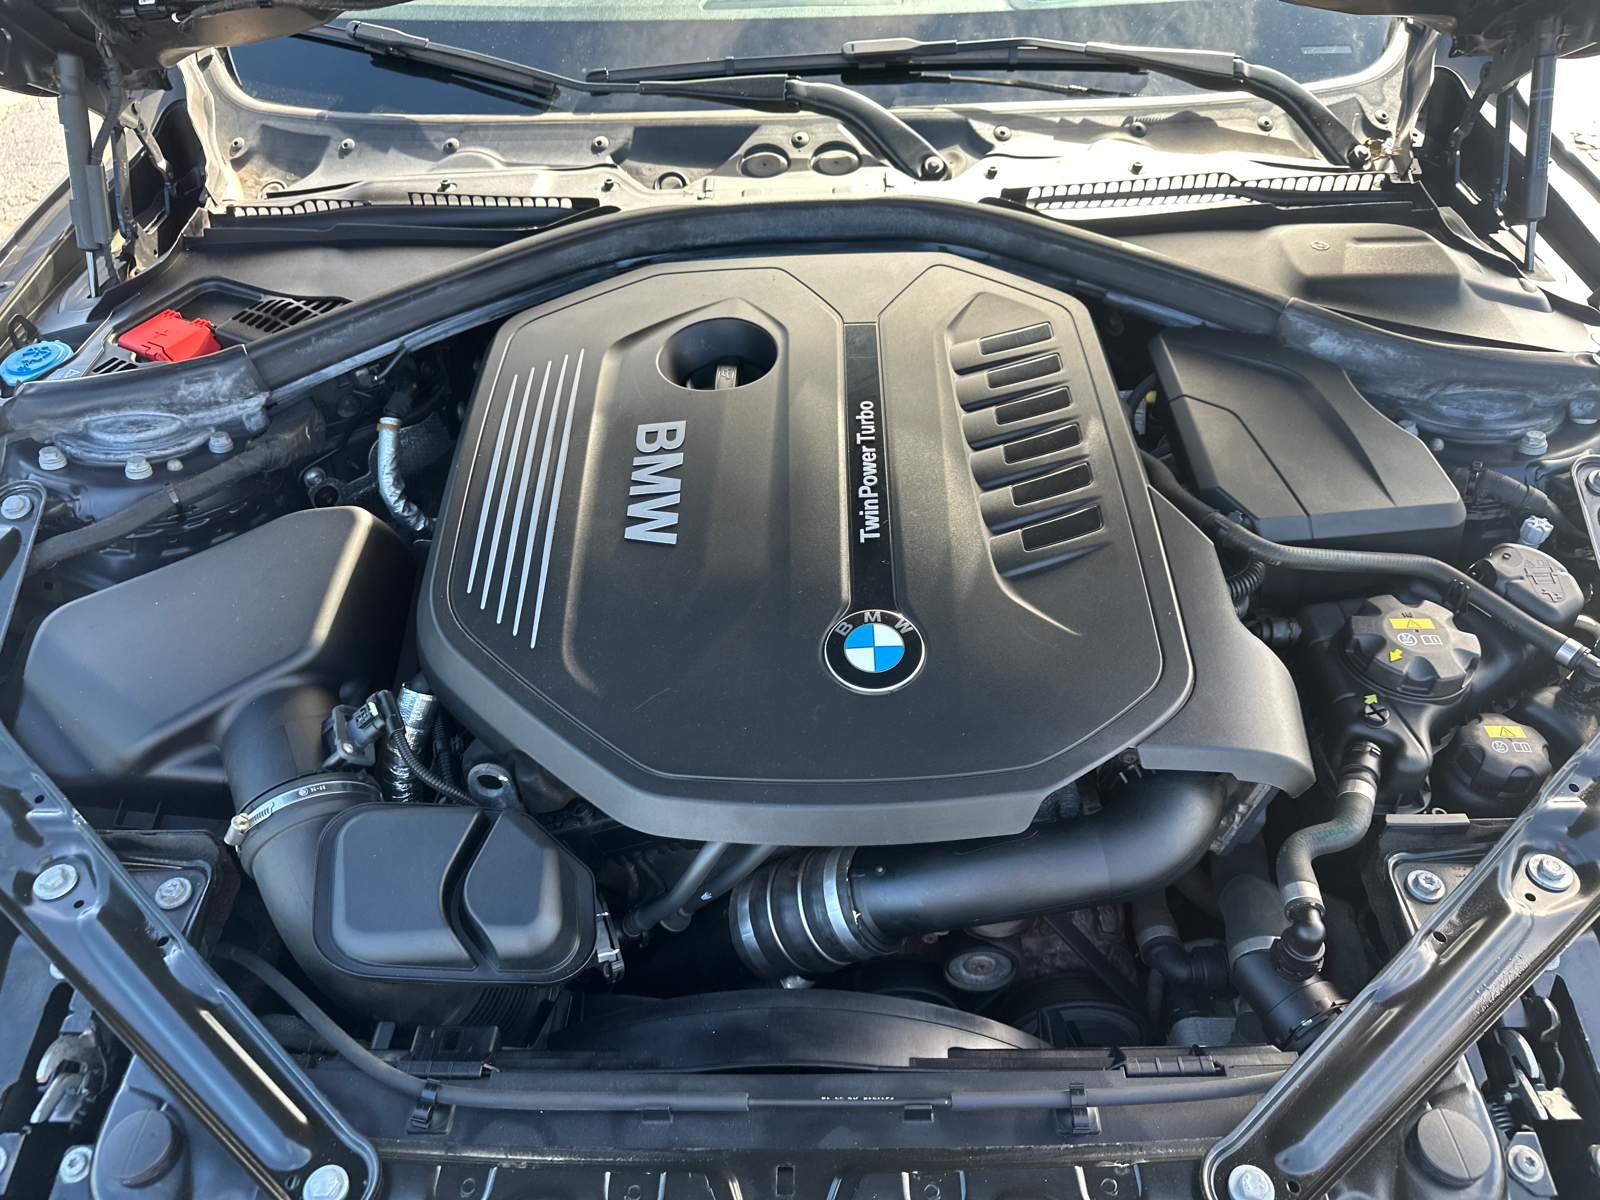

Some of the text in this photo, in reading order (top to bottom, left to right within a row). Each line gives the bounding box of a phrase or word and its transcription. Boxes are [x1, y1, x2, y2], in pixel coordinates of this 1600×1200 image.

[624, 420, 686, 545] BMW
[855, 400, 881, 543] TwinPower Turbo
[835, 611, 914, 637] BMW
